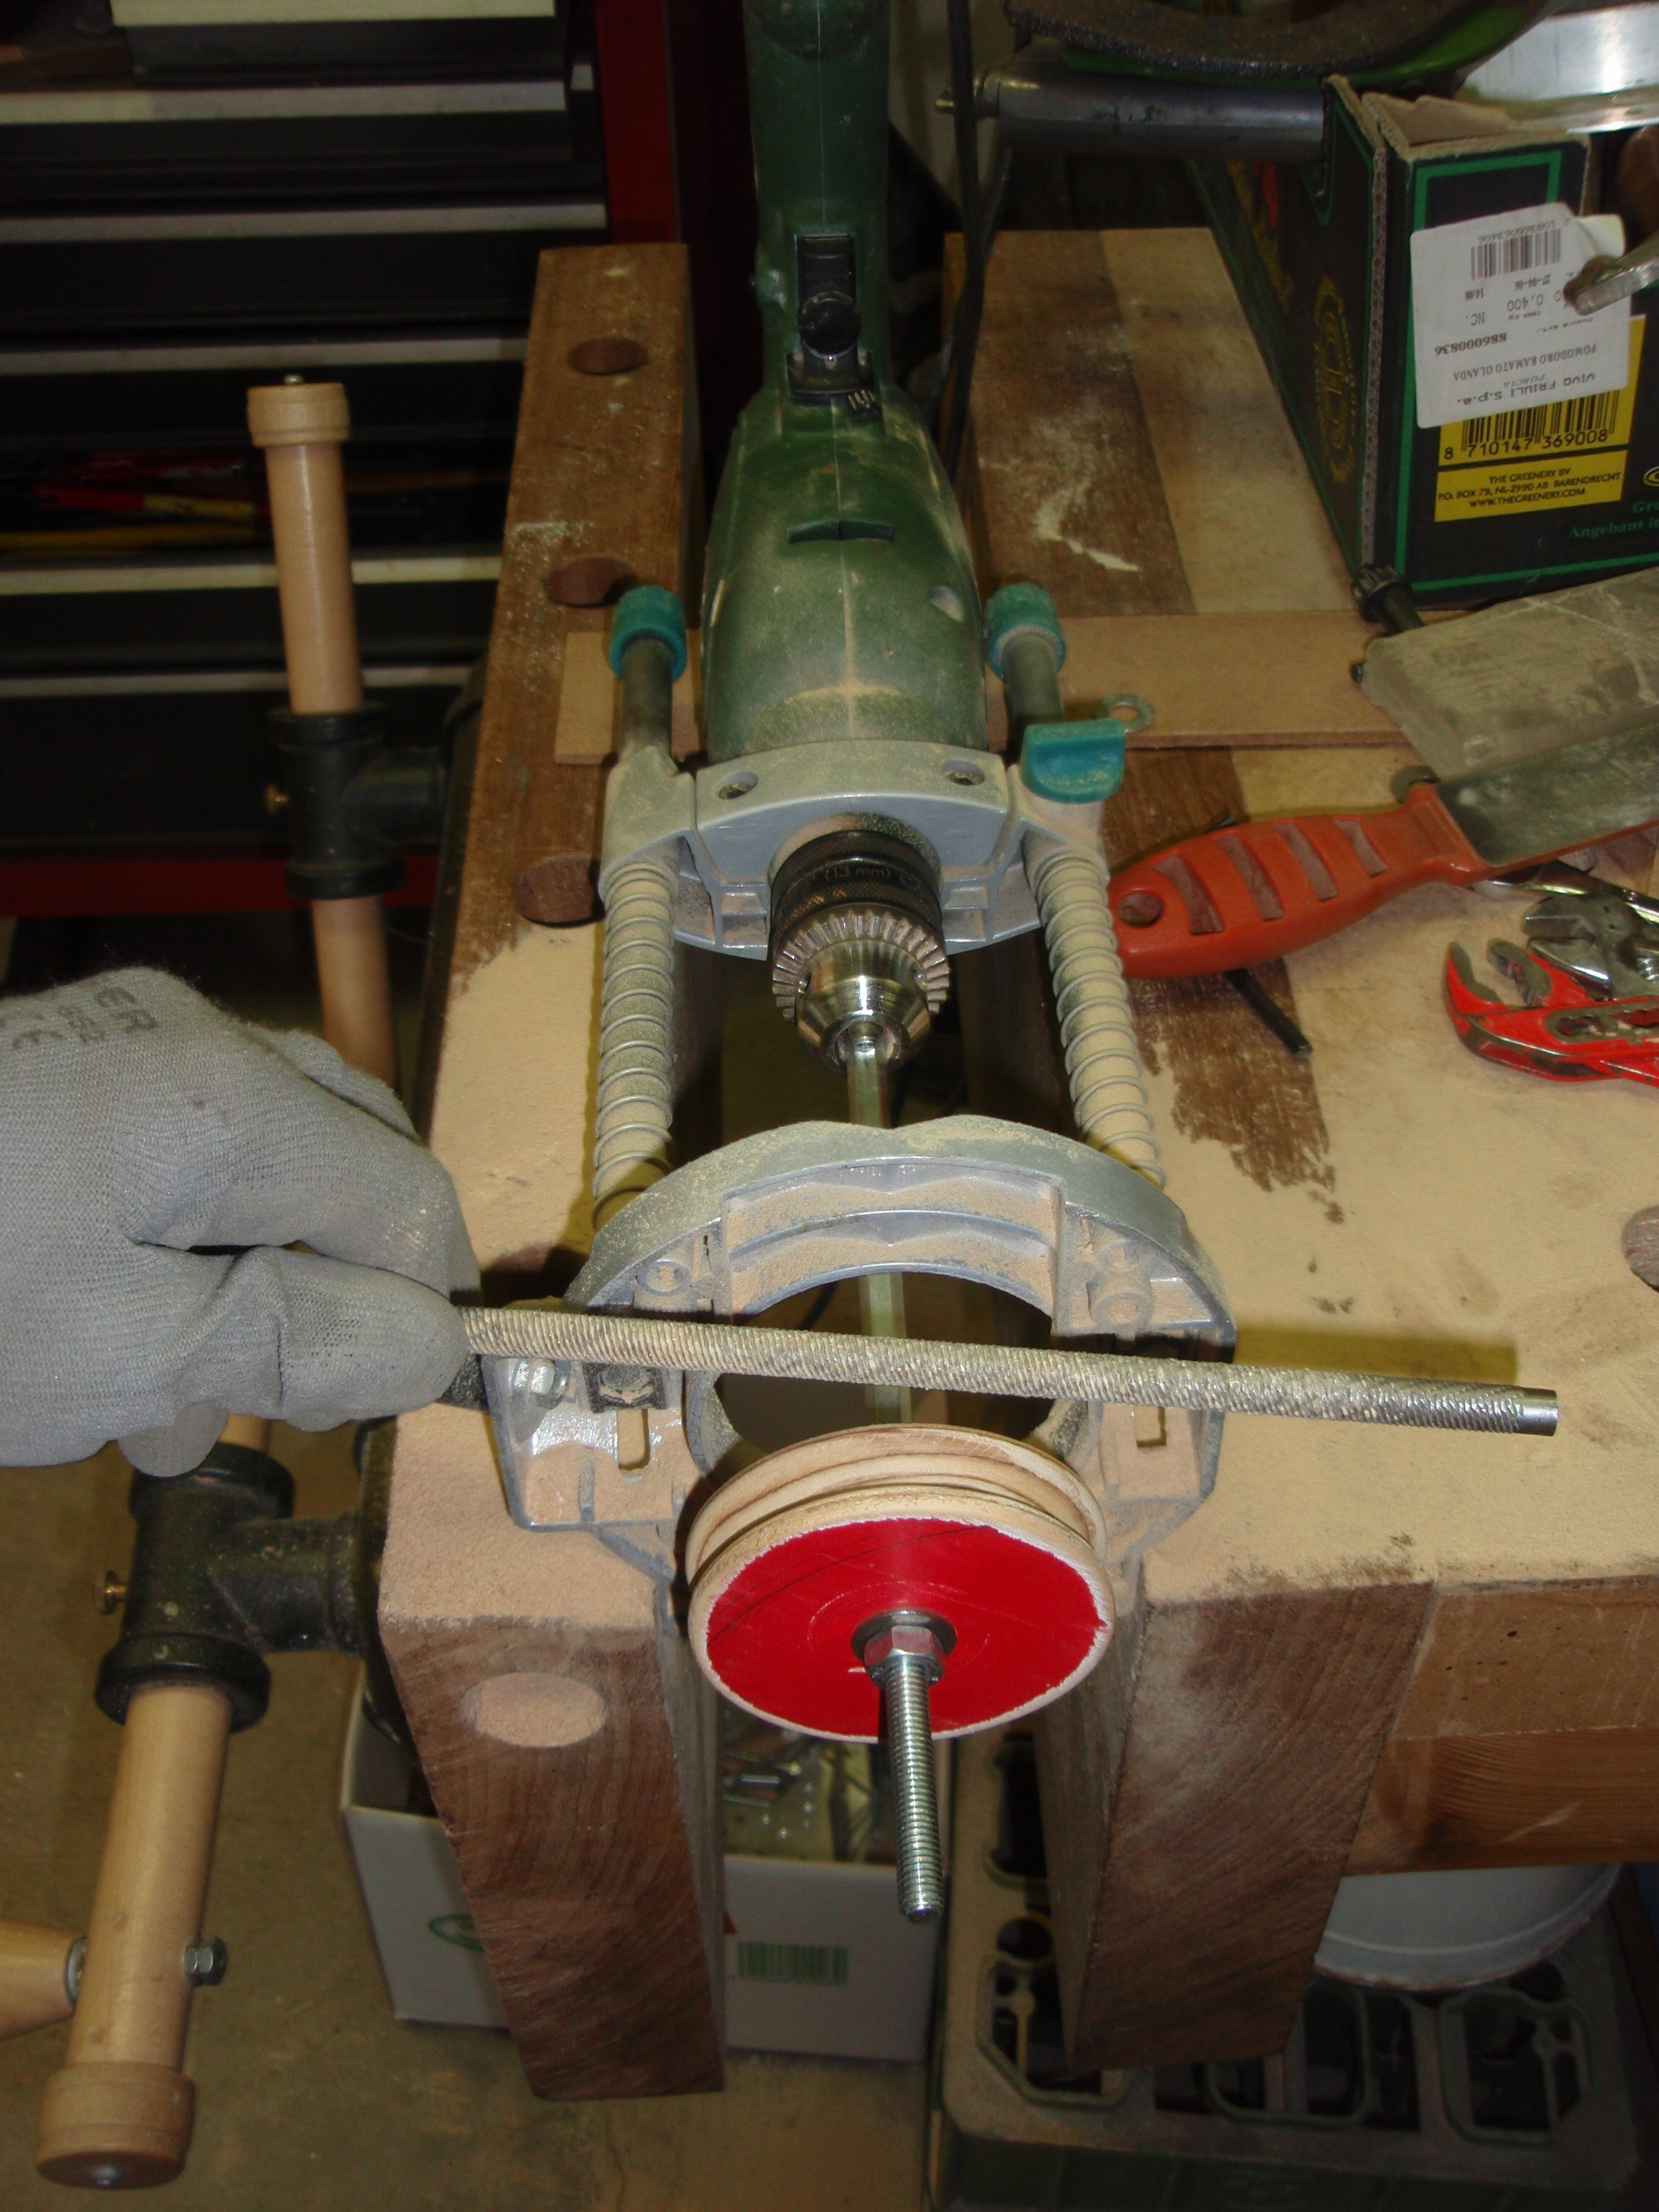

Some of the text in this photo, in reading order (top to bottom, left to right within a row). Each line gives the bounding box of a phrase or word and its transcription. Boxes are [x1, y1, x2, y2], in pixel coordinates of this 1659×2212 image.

[1507, 294, 1544, 312] 0,400
[1434, 332, 1508, 356] 886000836
[1453, 343, 1597, 382] POMODORO RAMATO OLANDA
[1457, 372, 1596, 405] VIVO FRIULI S.p.a.
[1444, 428, 1609, 460] 8 710147 369008
[1456, 490, 1476, 498] BOX
[1494, 482, 1534, 495] NL-2990
[1553, 472, 1622, 488] BARENDRECHT
[1488, 475, 1507, 485] THE
[1509, 469, 1555, 482] GREENERY
[1470, 487, 1586, 507] WWW.THEGREENERY.COM
[1568, 520, 1643, 539] Angebaut
[855, 867, 891, 879] mm)
